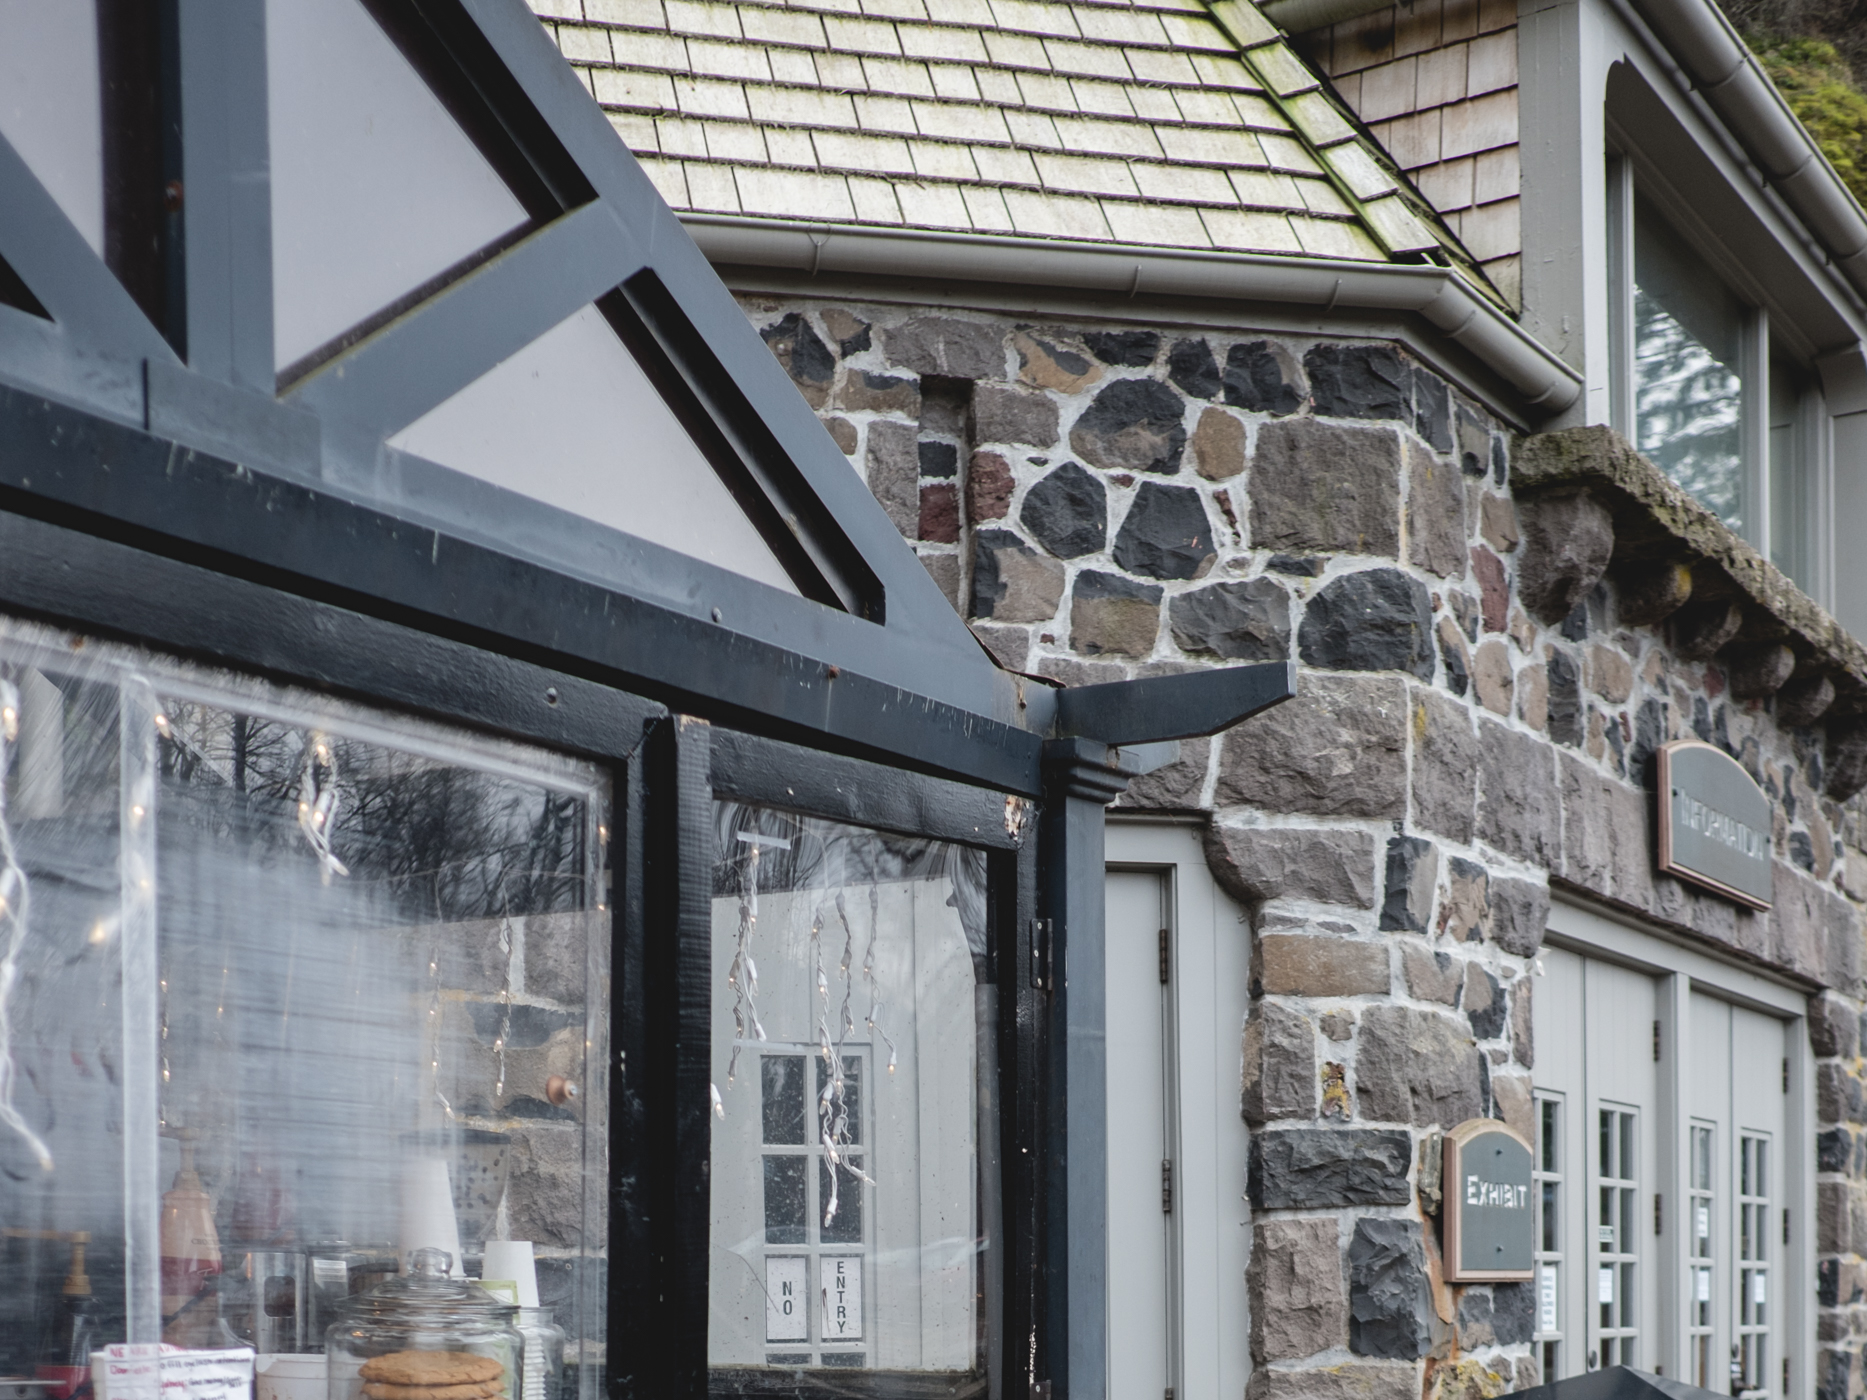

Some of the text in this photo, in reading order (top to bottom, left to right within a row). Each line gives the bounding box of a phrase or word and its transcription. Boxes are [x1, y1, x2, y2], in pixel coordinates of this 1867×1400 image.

[1467, 1174, 1527, 1209] EXHIBIT
[782, 1281, 792, 1315] NO
[836, 1261, 846, 1333] ENTRY
